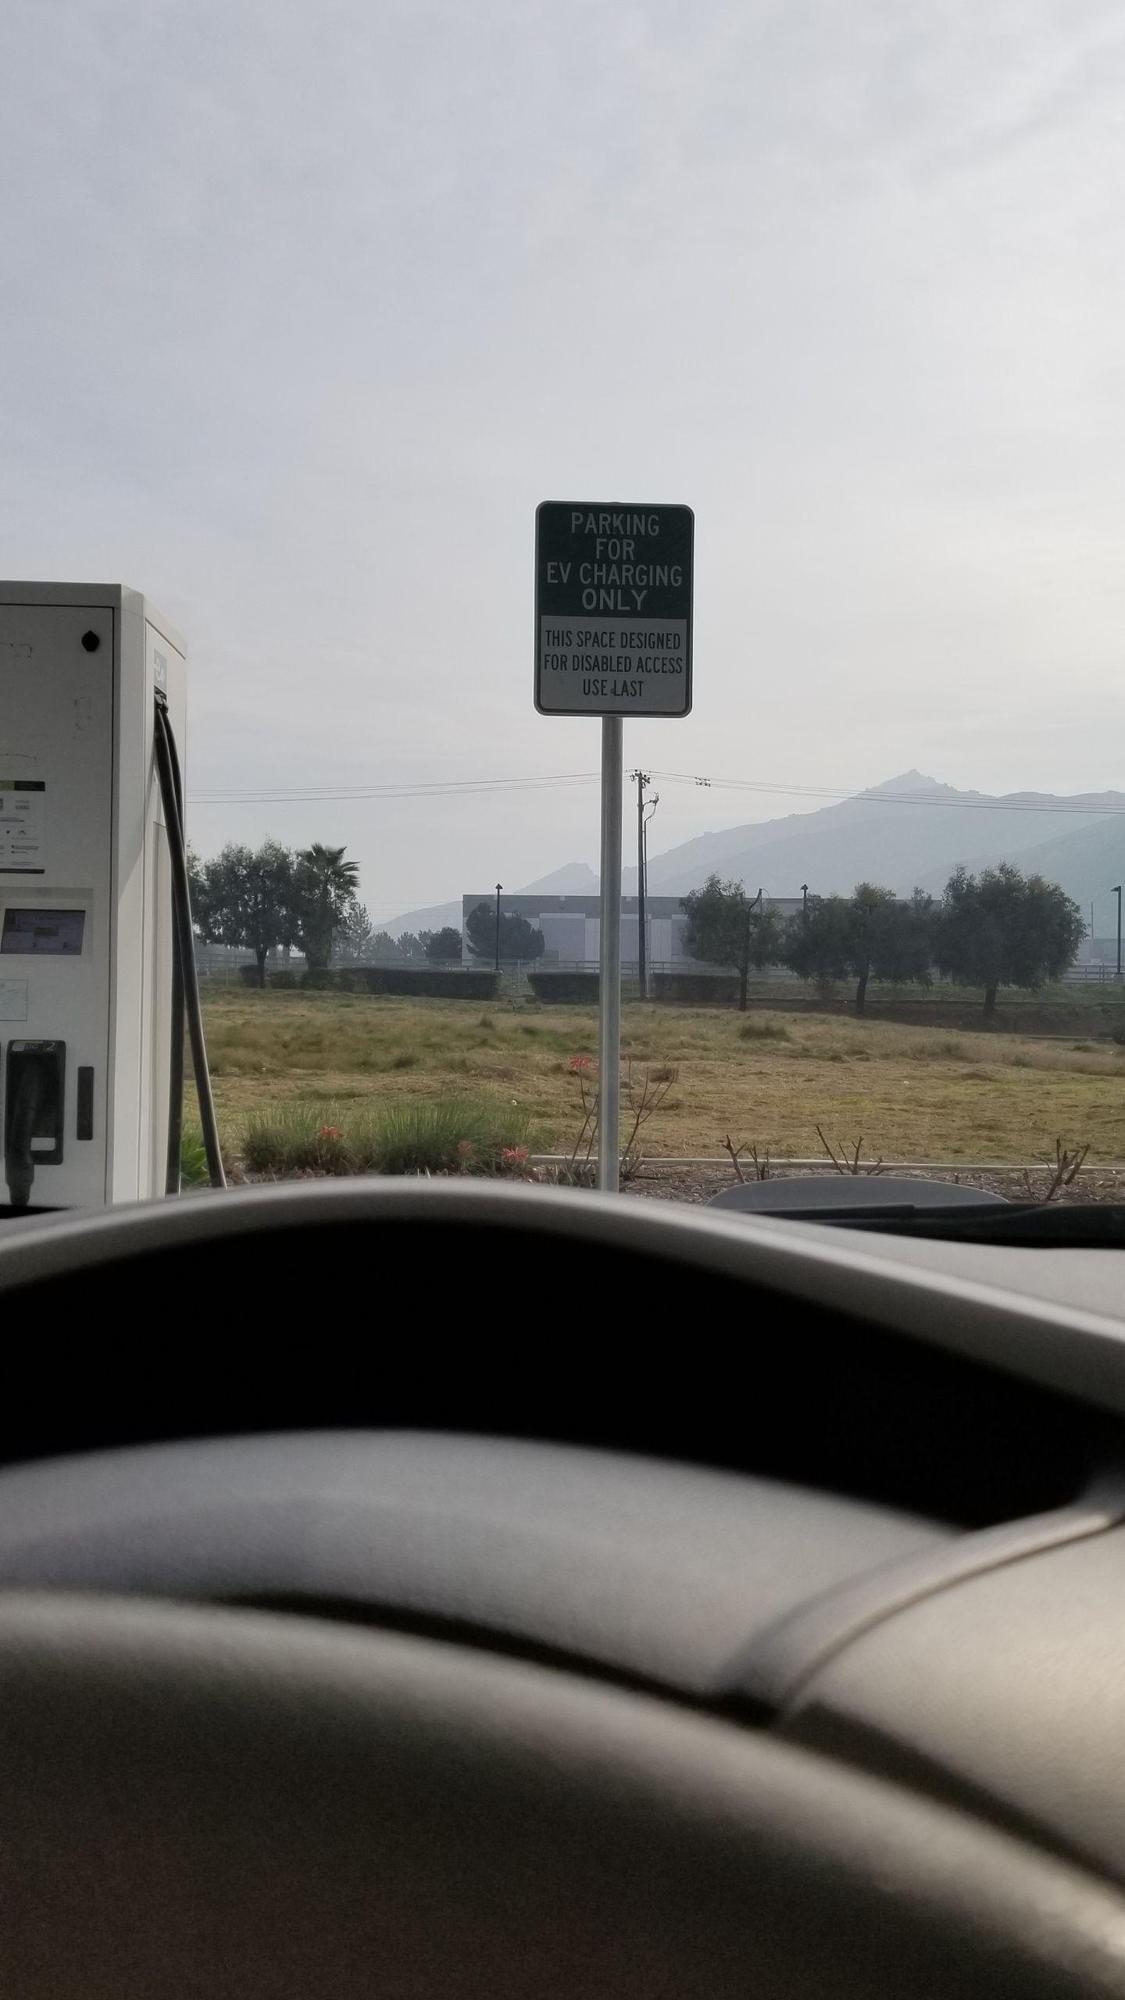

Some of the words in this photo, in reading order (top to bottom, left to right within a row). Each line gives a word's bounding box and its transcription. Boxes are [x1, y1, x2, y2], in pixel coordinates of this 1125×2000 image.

[571, 512, 660, 536] PARKING
[595, 538, 636, 561] FOR
[547, 562, 571, 584] EV
[579, 562, 683, 587] CHARGING
[582, 588, 647, 611] ONLY
[545, 630, 572, 648] THIS
[576, 631, 615, 649] SPACE
[621, 632, 681, 650] DESIGNED
[544, 654, 567, 671] FOR
[572, 655, 632, 673] DISABLED
[636, 656, 683, 674] ACCESS
[583, 679, 607, 696] USE
[613, 680, 644, 697] LAST
